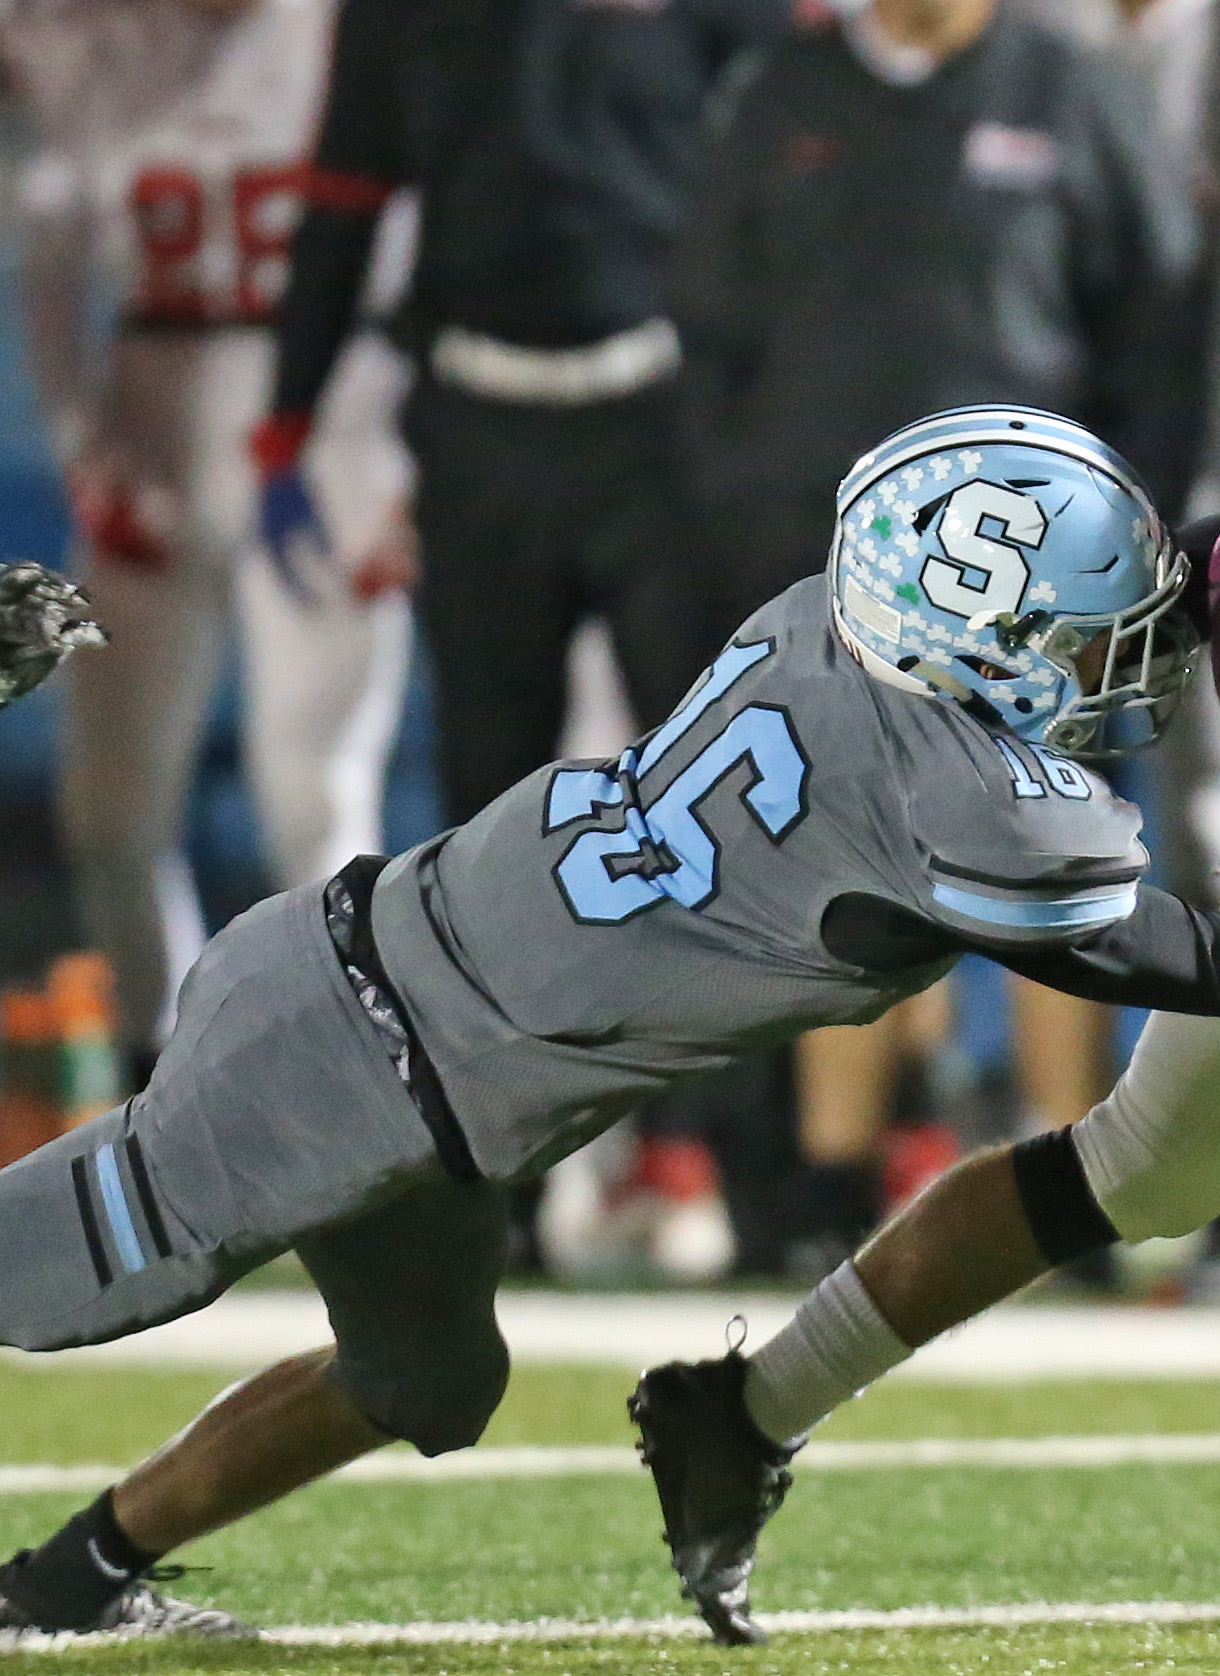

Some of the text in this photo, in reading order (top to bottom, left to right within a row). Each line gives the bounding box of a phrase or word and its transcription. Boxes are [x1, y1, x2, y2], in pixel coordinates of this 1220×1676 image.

[918, 477, 1050, 622] S
[542, 636, 813, 926] 16
[991, 736, 1092, 801] 16
